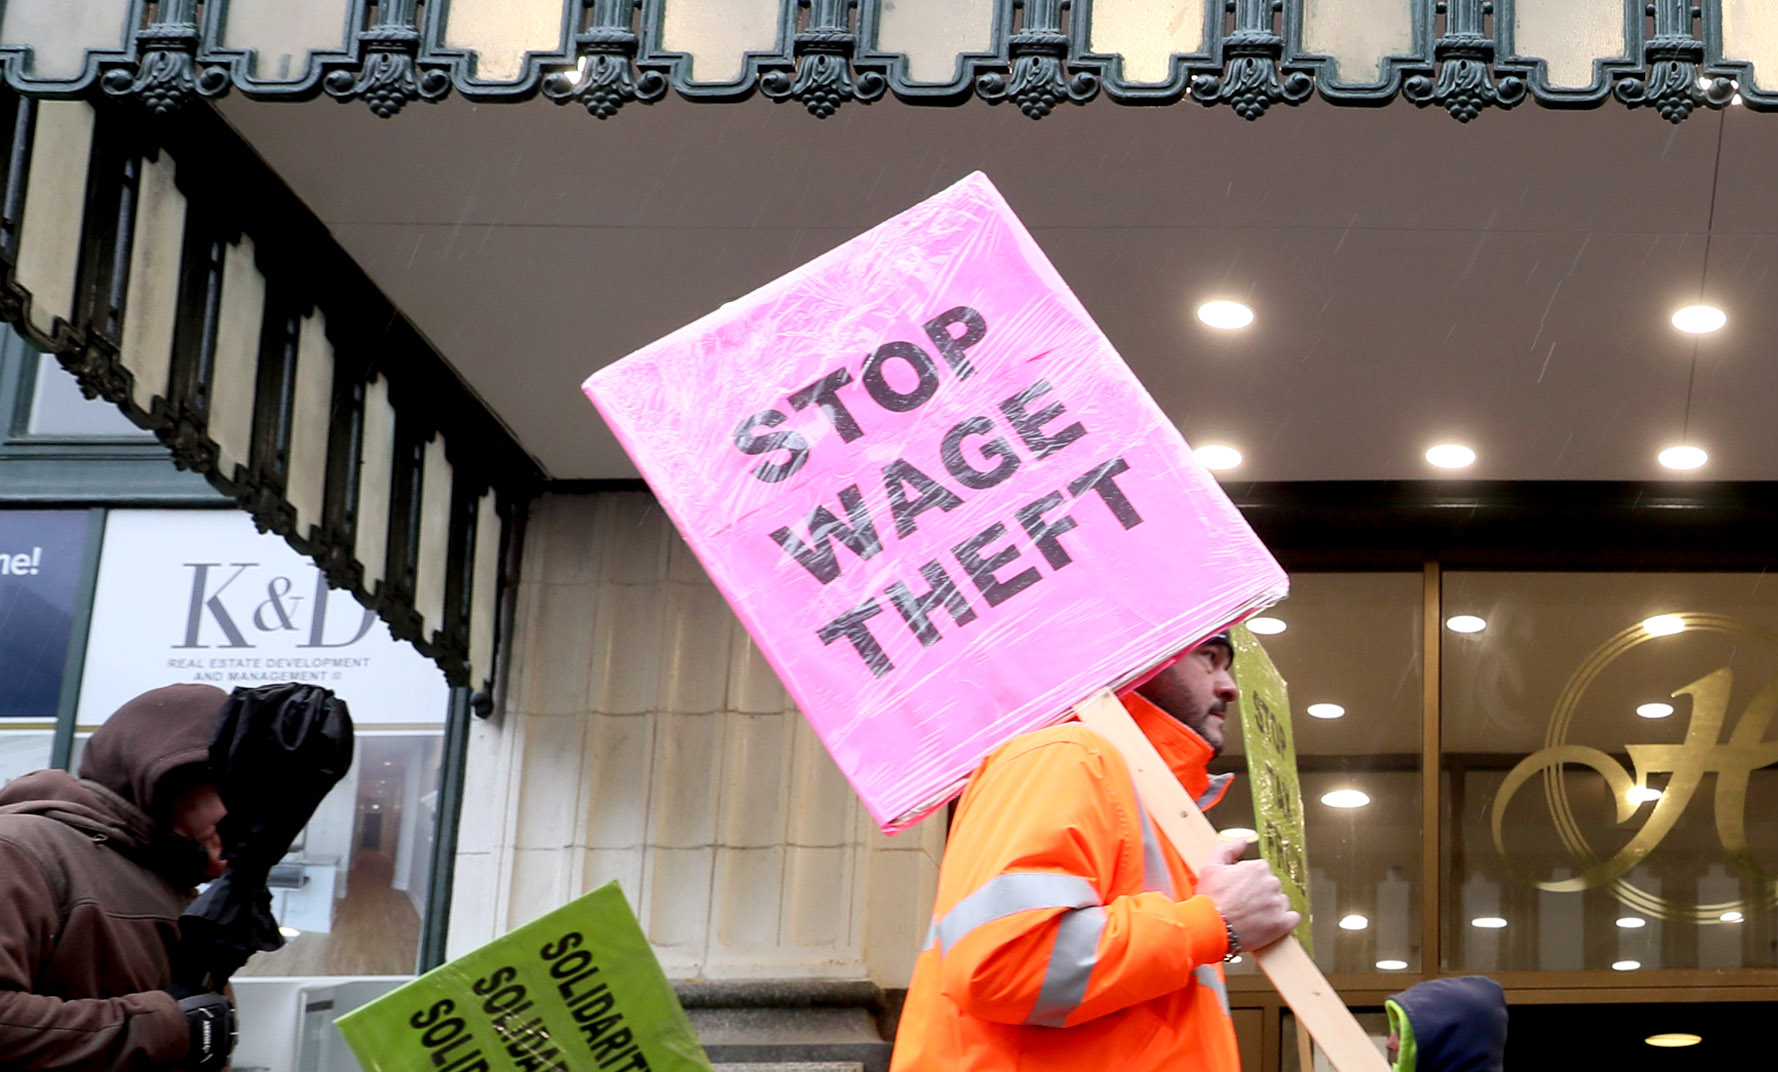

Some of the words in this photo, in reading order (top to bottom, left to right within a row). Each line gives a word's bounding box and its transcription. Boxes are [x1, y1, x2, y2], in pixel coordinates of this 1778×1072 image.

[734, 305, 988, 484] STOP
[768, 380, 1088, 586] WAGE
[170, 562, 377, 648] K&D
[815, 457, 1146, 679] THEFT
[167, 658, 206, 669] REAL
[209, 658, 262, 669] ESTATE
[265, 657, 371, 668] DEVELOPMENT
[193, 671, 223, 682] AND
[227, 671, 328, 682] MANAGEMENT
